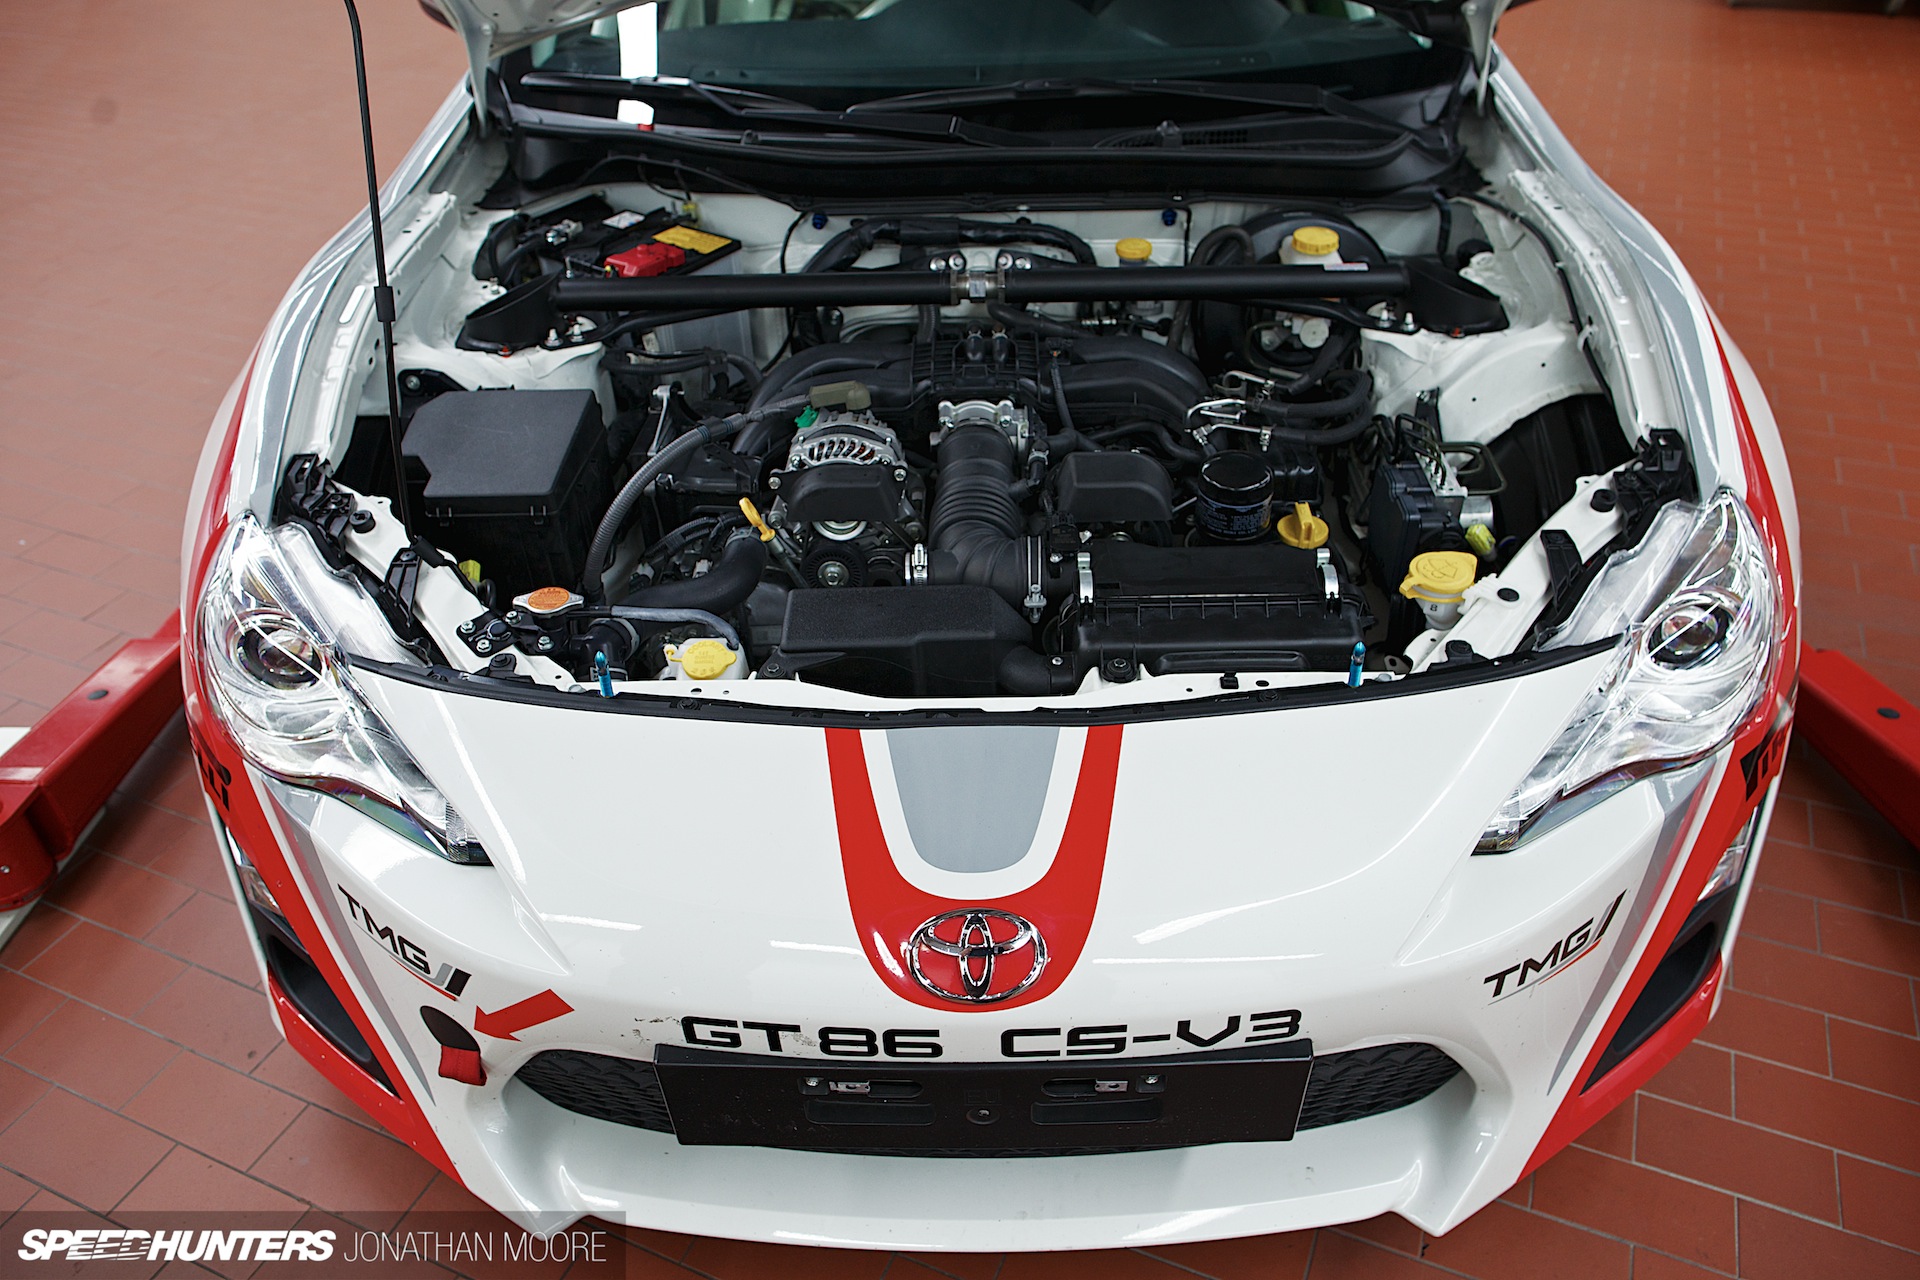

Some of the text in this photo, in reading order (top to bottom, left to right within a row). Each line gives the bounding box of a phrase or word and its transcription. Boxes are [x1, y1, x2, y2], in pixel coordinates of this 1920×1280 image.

[337, 883, 431, 975] TMG
[1483, 917, 1594, 998] TMG
[1000, 1009, 1302, 1058] CS-V3
